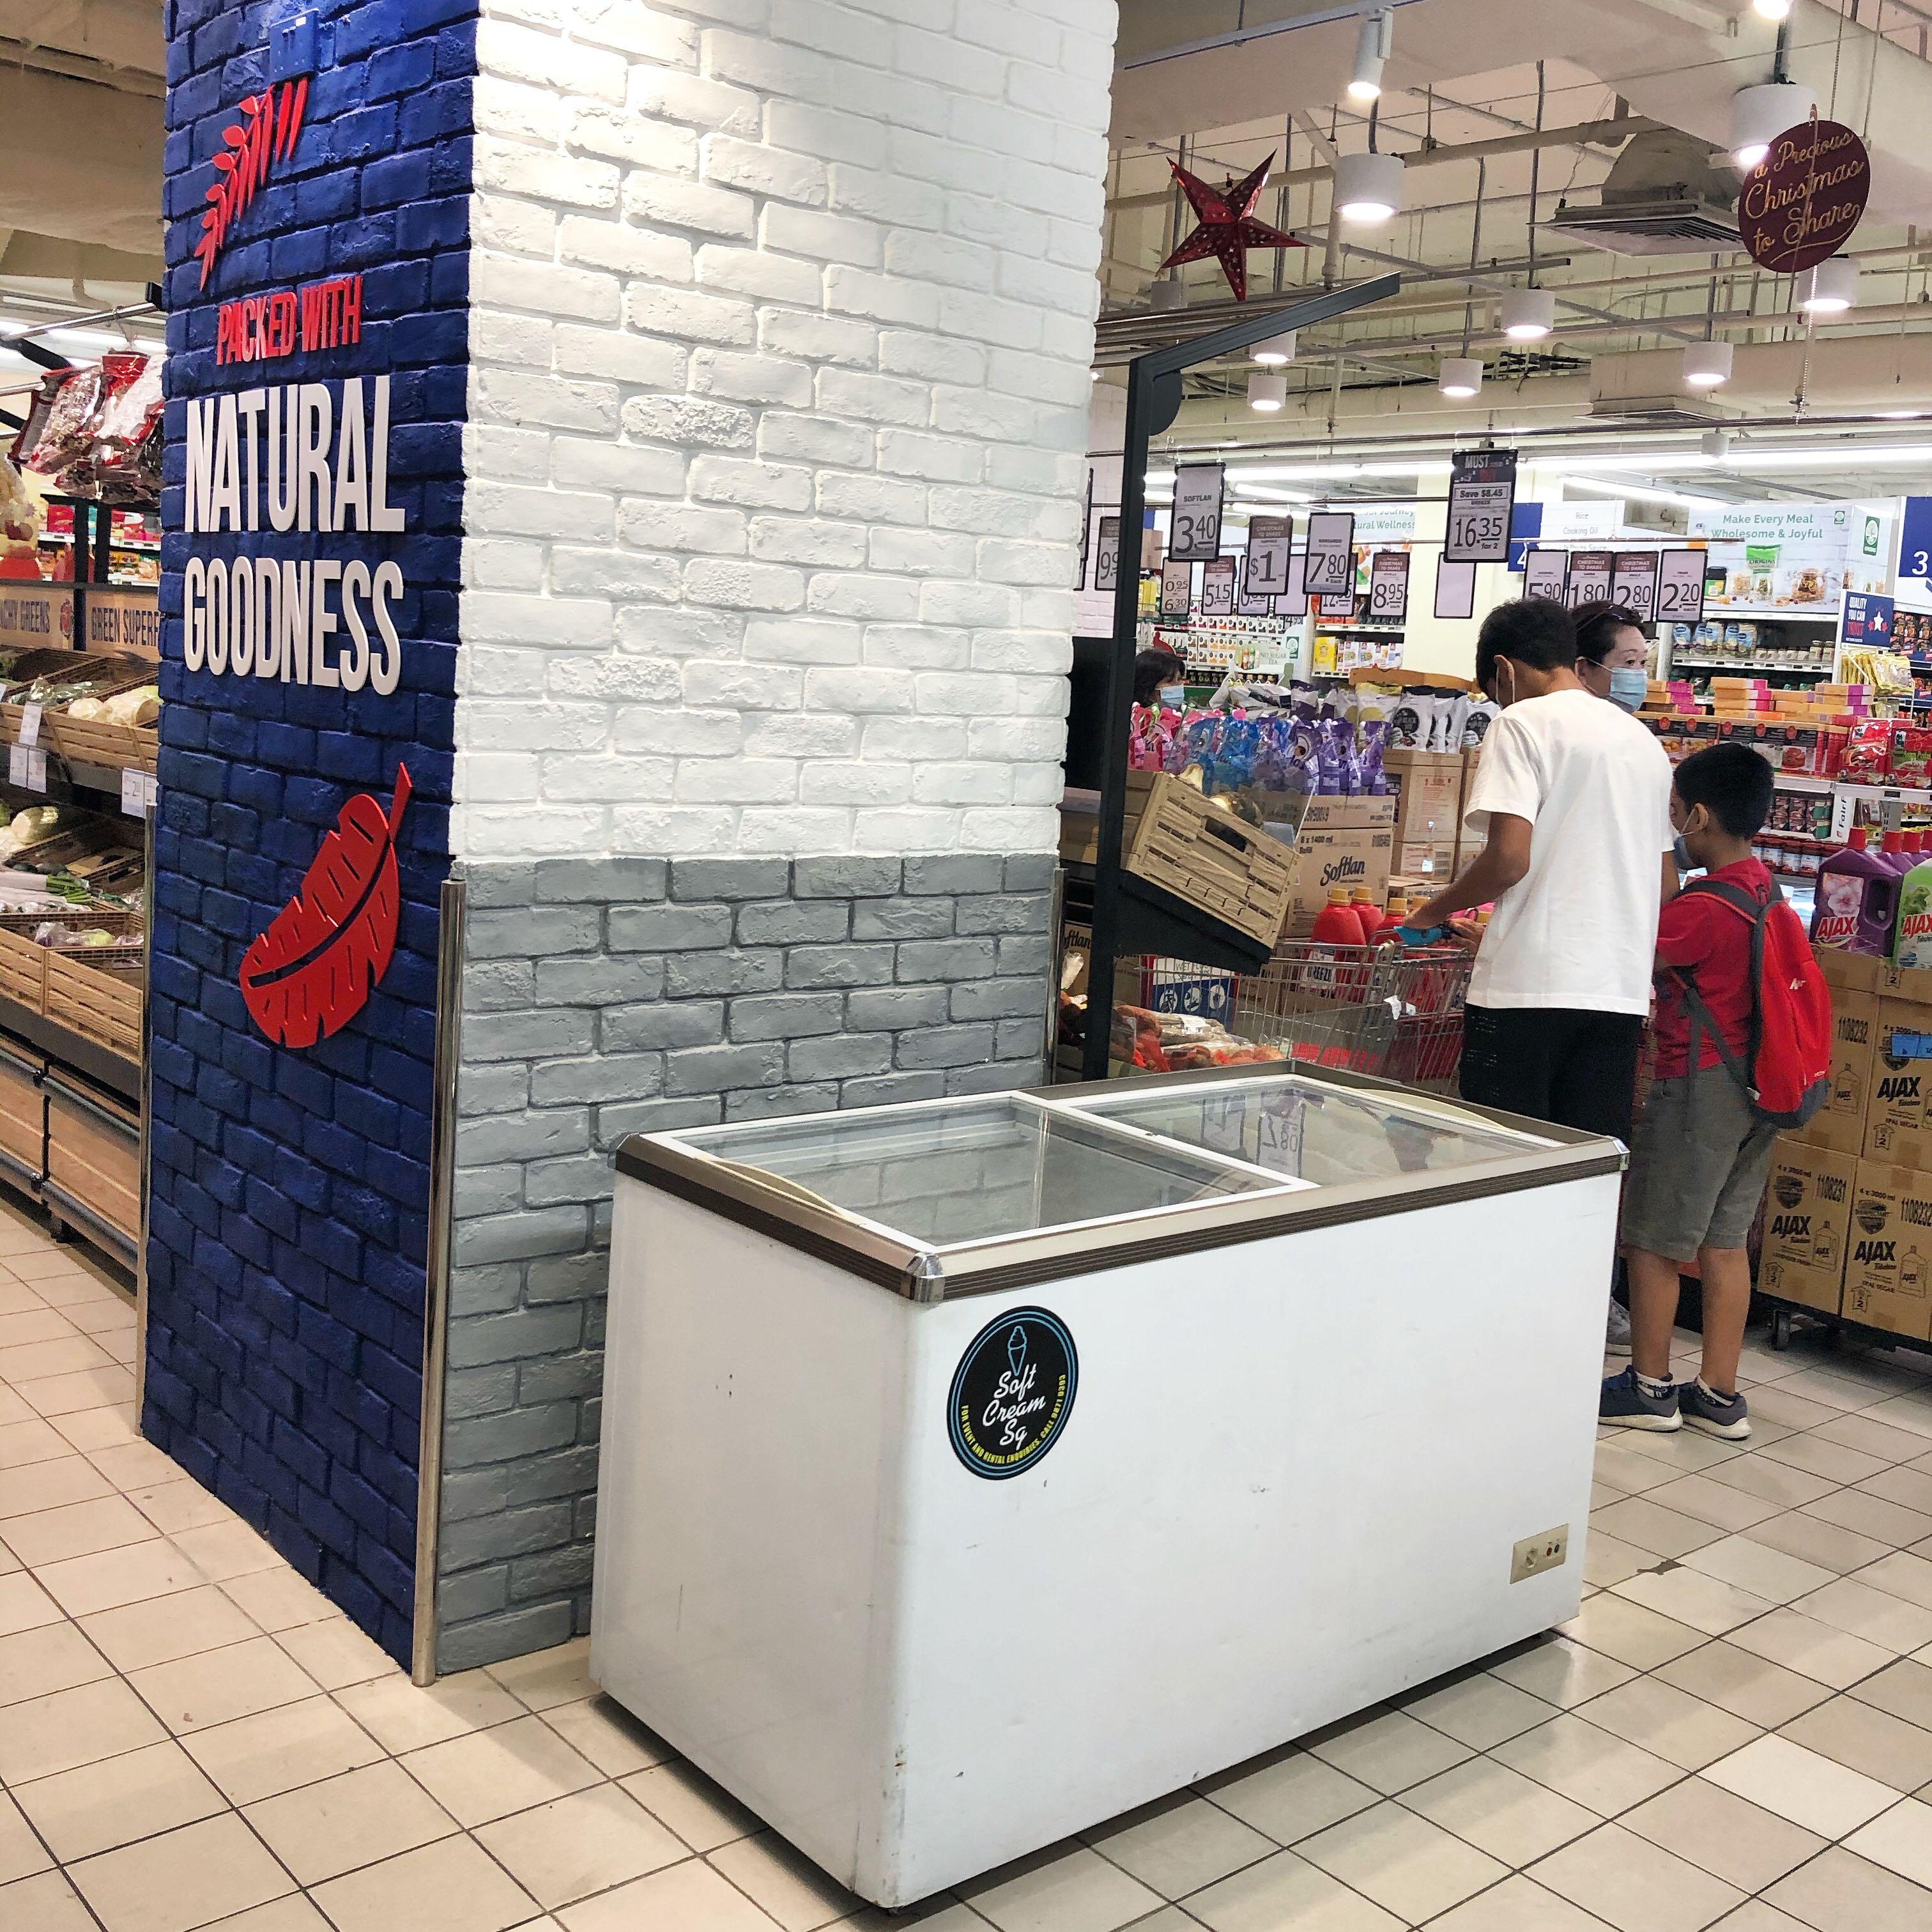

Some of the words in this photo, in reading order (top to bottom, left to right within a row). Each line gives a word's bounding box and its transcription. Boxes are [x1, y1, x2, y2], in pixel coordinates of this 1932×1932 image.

[1754, 163, 1768, 179] a
[1774, 132, 1855, 172] Precious
[1745, 160, 1865, 219] Christmas
[1753, 227, 1775, 256] to
[1781, 201, 1861, 246] Share
[217, 291, 298, 366] PACKED
[300, 275, 364, 353] WITH
[185, 374, 406, 533] NATURAL
[1464, 454, 1490, 469] MUST
[1183, 494, 1212, 503] SOFTLAN
[1460, 490, 1479, 498] Save
[1174, 514, 1216, 555] 3.40
[1353, 521, 1374, 530] tural
[1453, 517, 1503, 548] 16.35
[1711, 528, 1775, 539] Wholesome
[1778, 529, 1785, 538] &
[1788, 528, 1823, 541] Joyful
[1722, 514, 1751, 524] Make
[1754, 514, 1784, 526] Every
[1786, 514, 1814, 524] Meal
[1250, 550, 1277, 583] $1
[1308, 553, 1347, 583] 7.80
[1912, 550, 1929, 575] 3
[1204, 584, 1230, 608] 5.15
[1374, 583, 1404, 609] 8.95
[1661, 583, 1700, 611] 2.20
[123, 608, 159, 647] SUPERF
[184, 555, 405, 696] GOODNESS
[1838, 796, 1848, 828] FairP
[1320, 856, 1365, 887] Softlan
[1817, 916, 1856, 941] AJAX
[1876, 1077, 1922, 1102] AJAX
[1770, 1215, 1812, 1239] AJAX
[1853, 1241, 1897, 1266] AJAX
[993, 1363, 1037, 1402] Soft
[961, 1404, 969, 1422] FOR
[982, 1395, 1046, 1427] Cream
